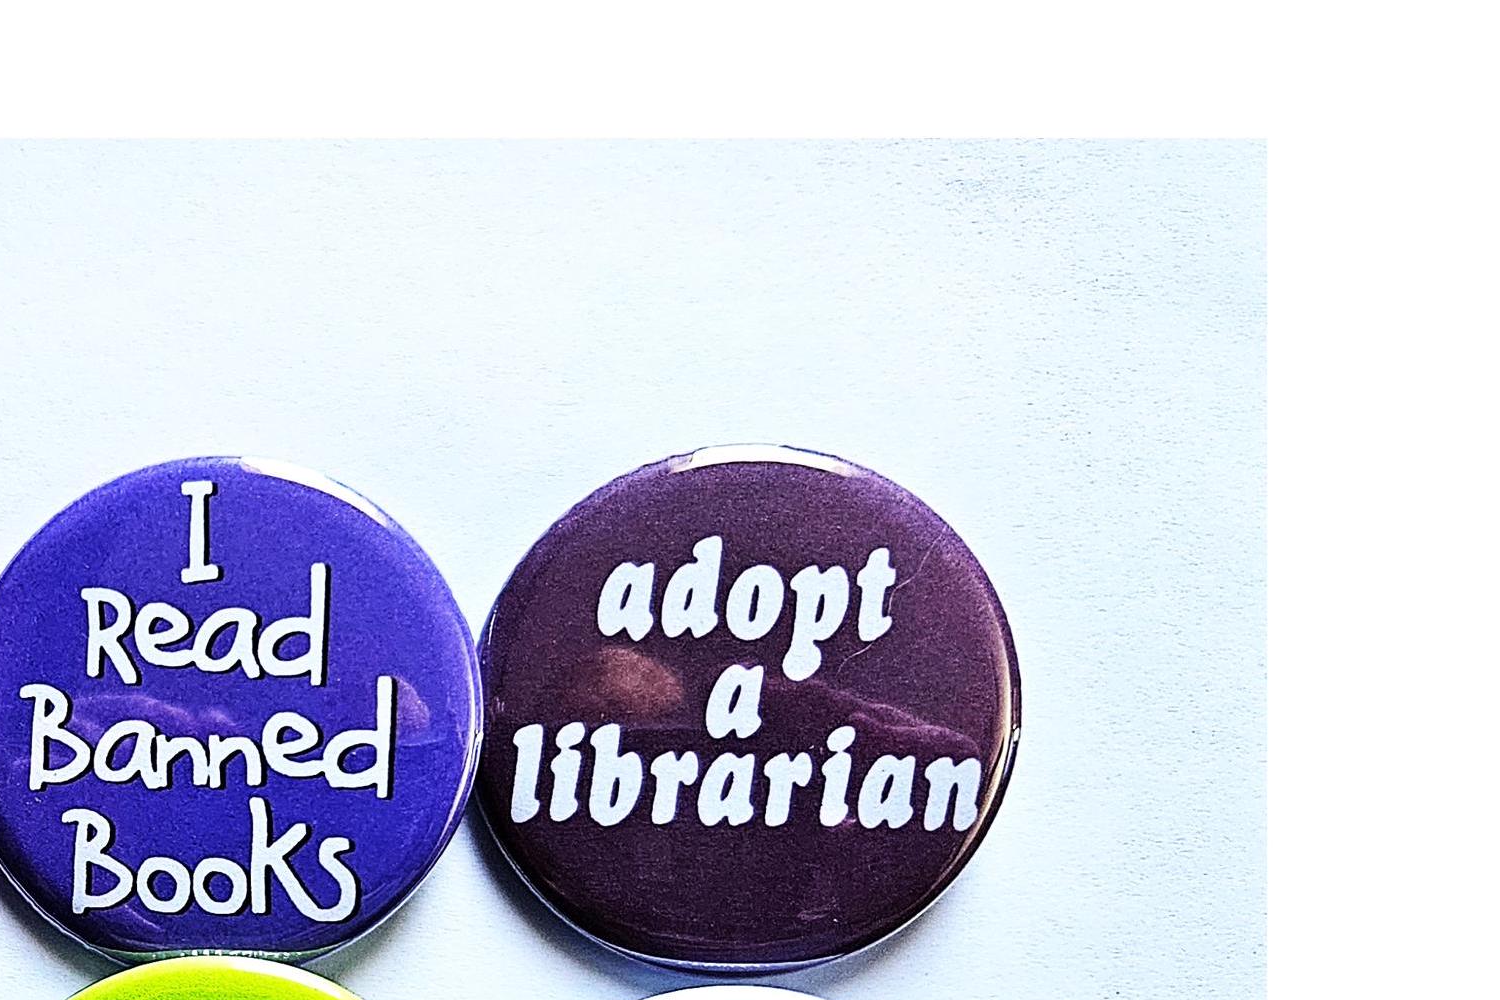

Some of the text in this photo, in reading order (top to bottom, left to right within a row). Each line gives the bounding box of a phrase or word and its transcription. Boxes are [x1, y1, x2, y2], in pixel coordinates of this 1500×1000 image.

[181, 480, 223, 583] I
[81, 562, 331, 686] Read
[597, 535, 897, 681] adopt
[20, 675, 398, 798] Banned
[705, 664, 764, 739] a
[510, 722, 982, 832] librarian
[61, 797, 361, 924] Books
